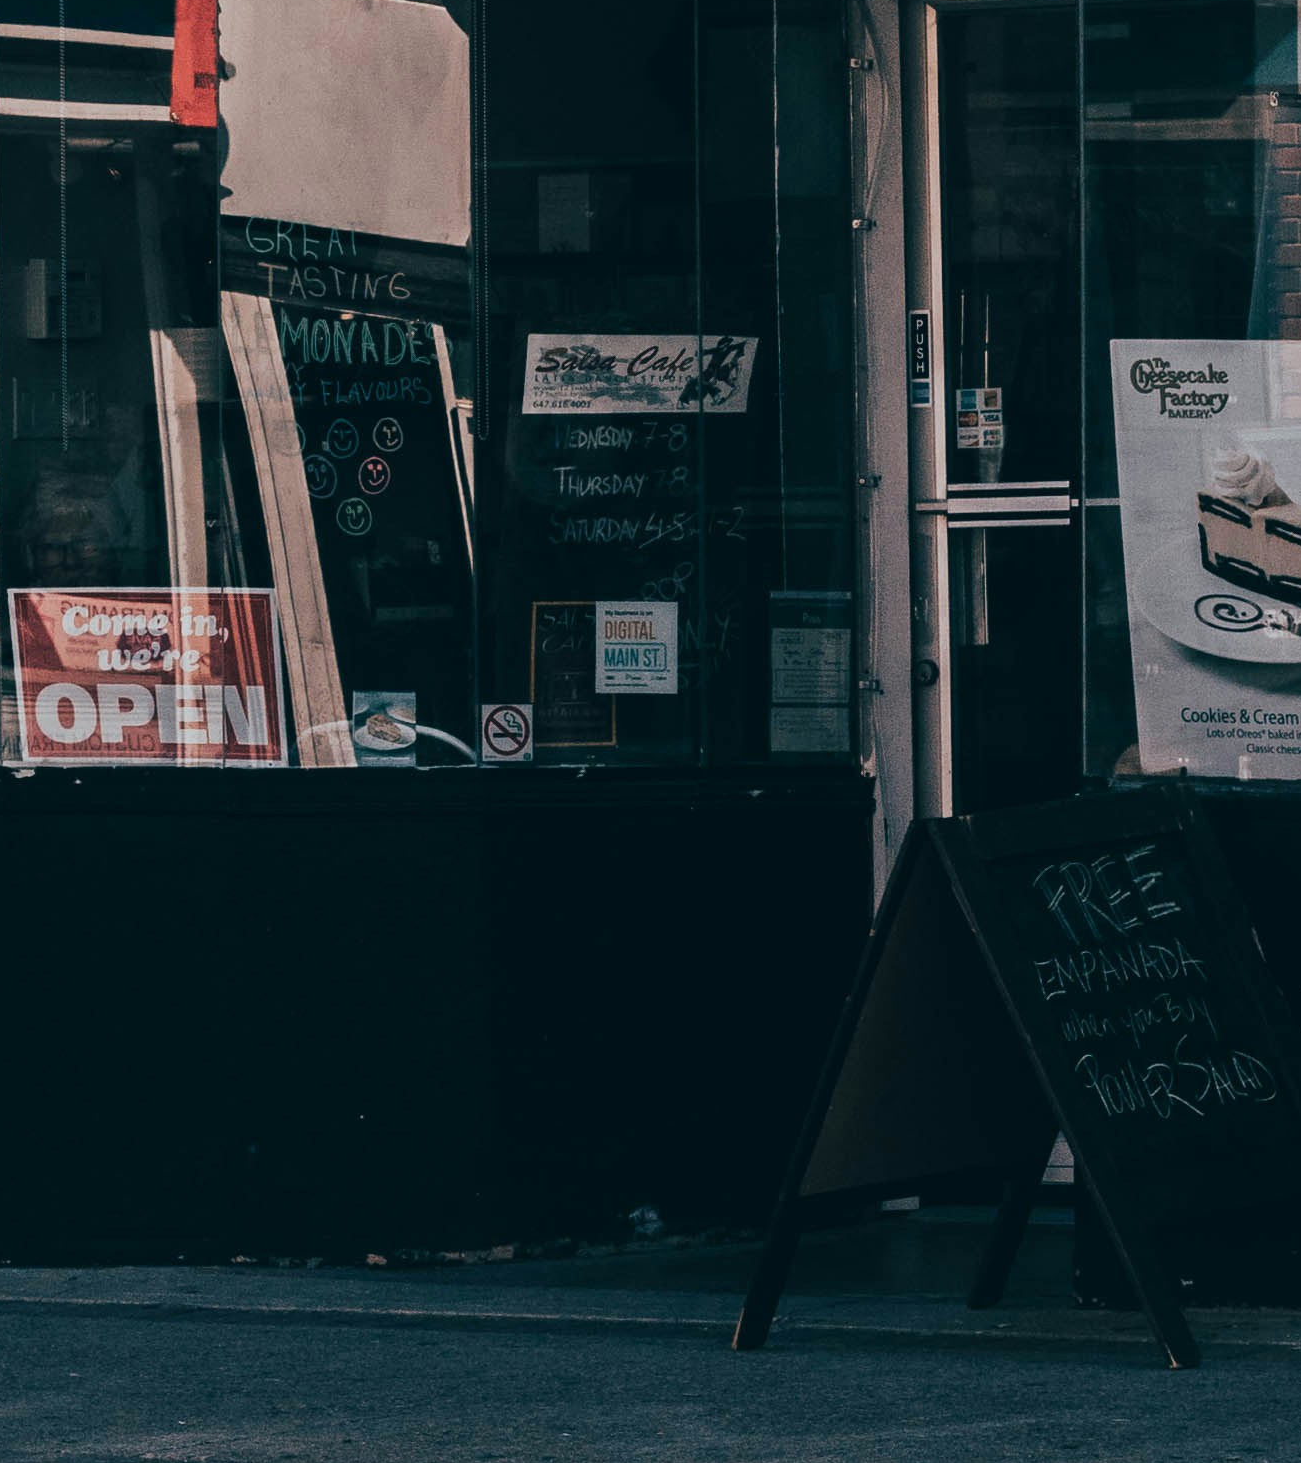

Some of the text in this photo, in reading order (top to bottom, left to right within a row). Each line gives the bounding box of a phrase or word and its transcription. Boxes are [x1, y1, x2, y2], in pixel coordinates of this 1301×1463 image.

[257, 262, 412, 300] TASTING
[535, 345, 617, 373] Salsa
[915, 319, 926, 374] PUSH
[1152, 357, 1171, 368] The
[321, 376, 433, 406] FLAVOURS
[1130, 359, 1229, 394] Cheesecake
[1151, 383, 1230, 415] Factory
[61, 604, 176, 637] Come
[604, 620, 656, 640] DIGITAL
[97, 640, 202, 674] we're
[604, 647, 639, 667] MAIN
[33, 682, 270, 747] OPEN
[1180, 707, 1237, 724] Cookies
[1239, 708, 1251, 725] &
[1253, 709, 1300, 726] Cream
[1206, 728, 1226, 738] Lots
[1267, 729, 1295, 740] baked
[1246, 743, 1275, 754] Classic
[1033, 844, 1181, 945] FREE
[1033, 937, 1208, 1001] EMPANADA
